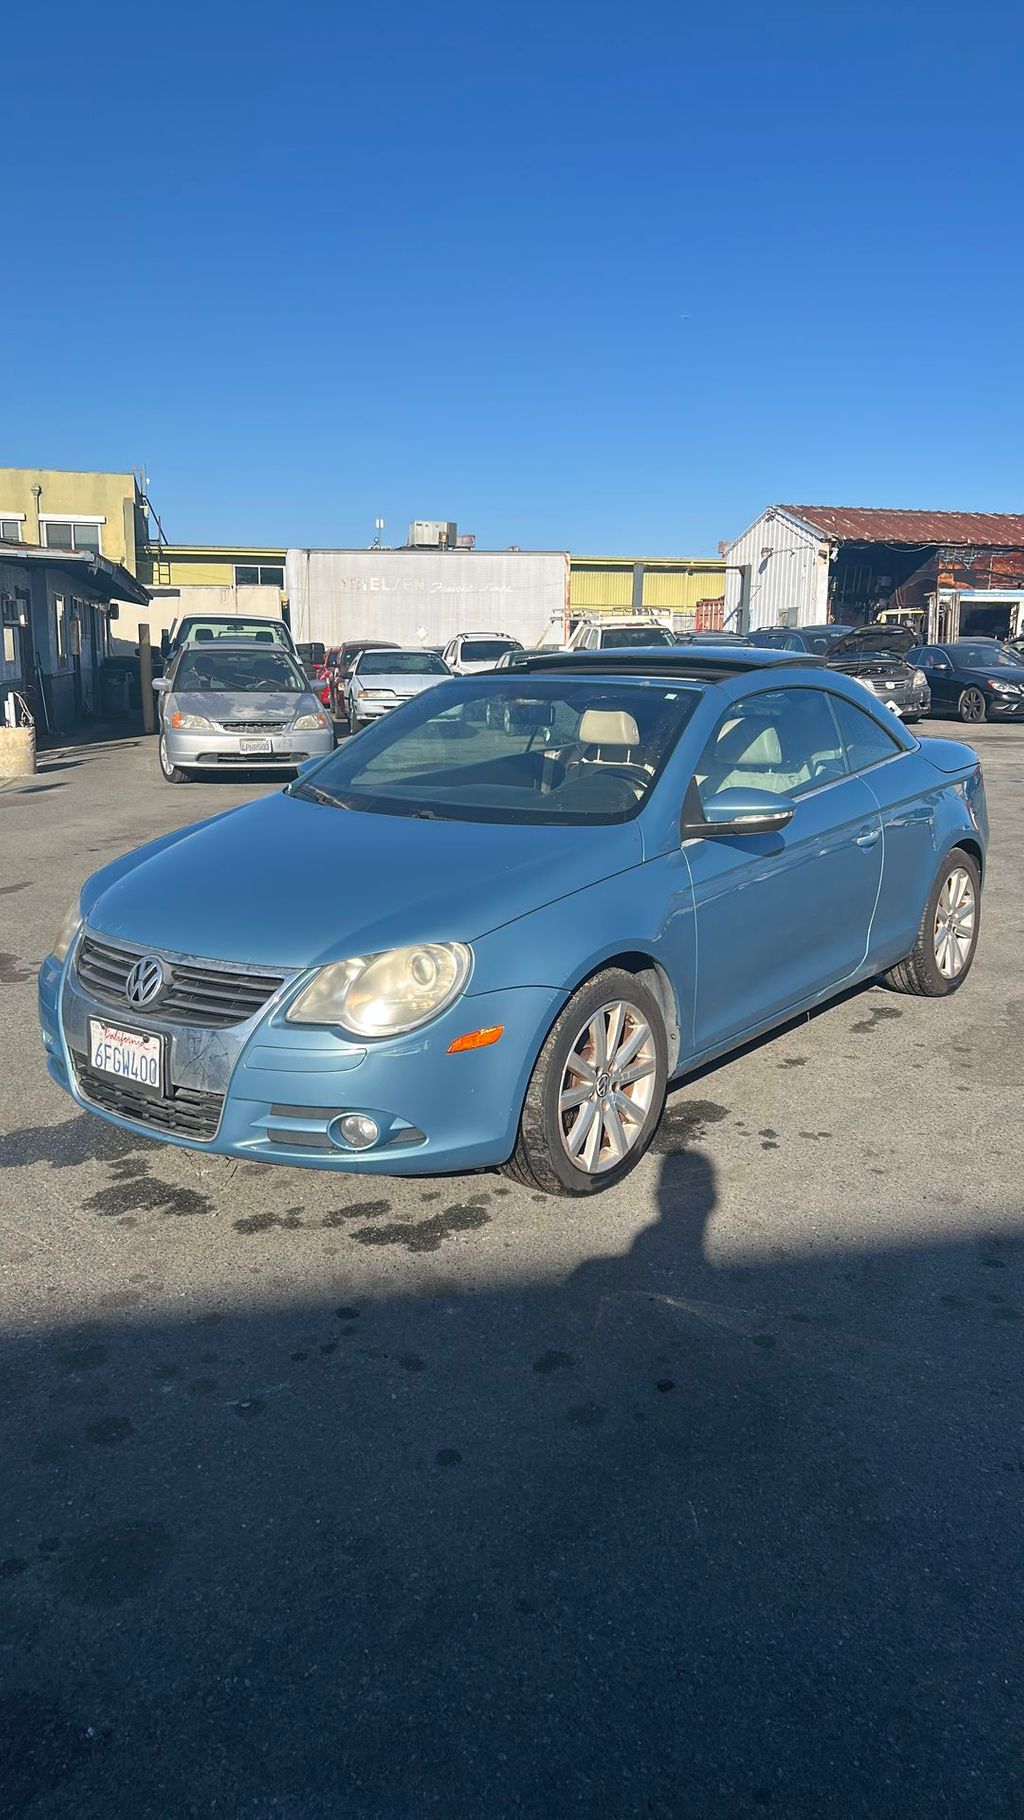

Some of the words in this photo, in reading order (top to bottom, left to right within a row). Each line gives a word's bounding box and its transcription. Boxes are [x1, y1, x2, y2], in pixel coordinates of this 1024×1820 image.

[349, 577, 425, 592] IELSEN
[104, 1027, 150, 1050] California
[95, 1042, 157, 1085] 6FGW400
